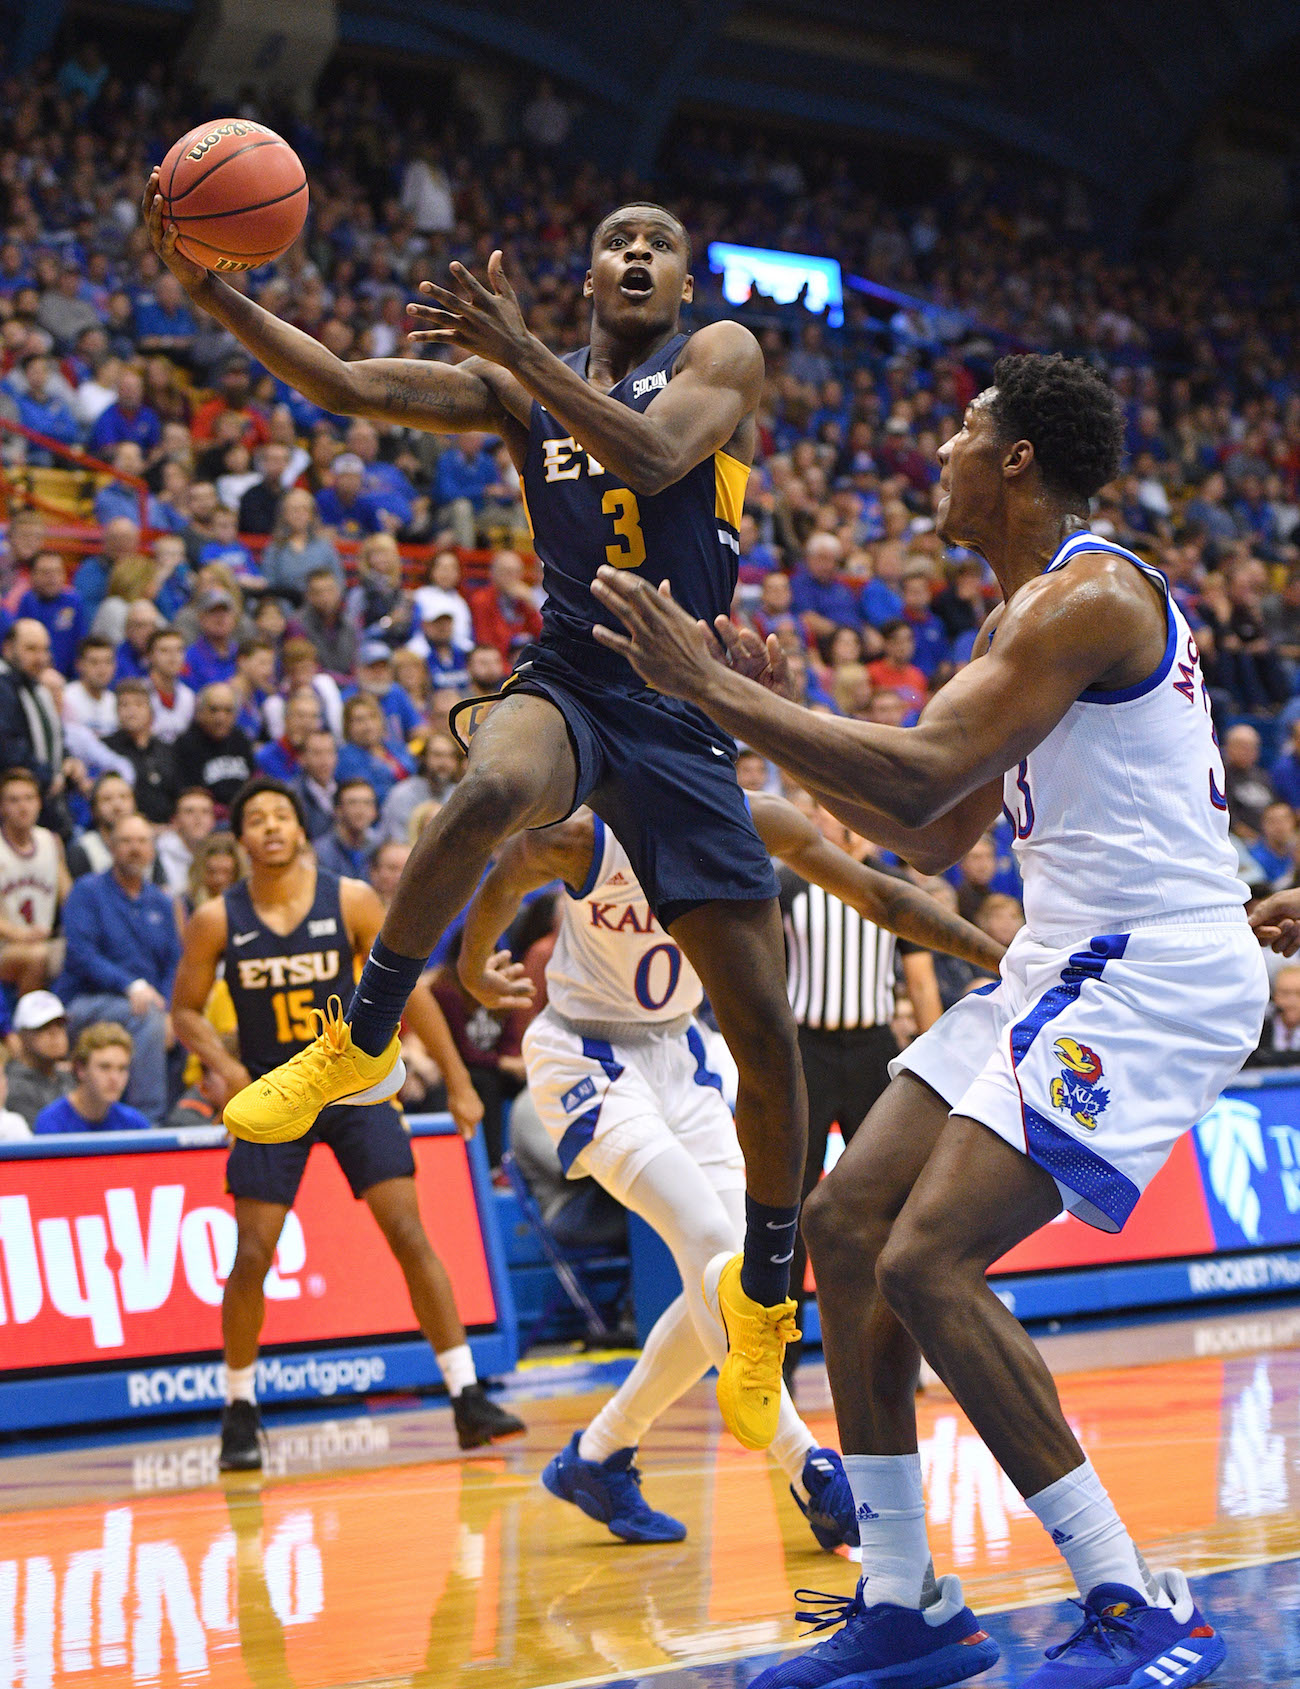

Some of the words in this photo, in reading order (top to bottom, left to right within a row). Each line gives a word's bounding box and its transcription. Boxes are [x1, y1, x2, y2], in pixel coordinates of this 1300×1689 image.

[632, 370, 668, 399] SOCON
[601, 487, 647, 569] 3
[238, 950, 340, 990] ETSU
[272, 979, 319, 1044] 15
[1071, 1083, 1093, 1104] KU
[127, 1365, 229, 1408] ROCKE
[257, 1356, 386, 1396] Mortgage
